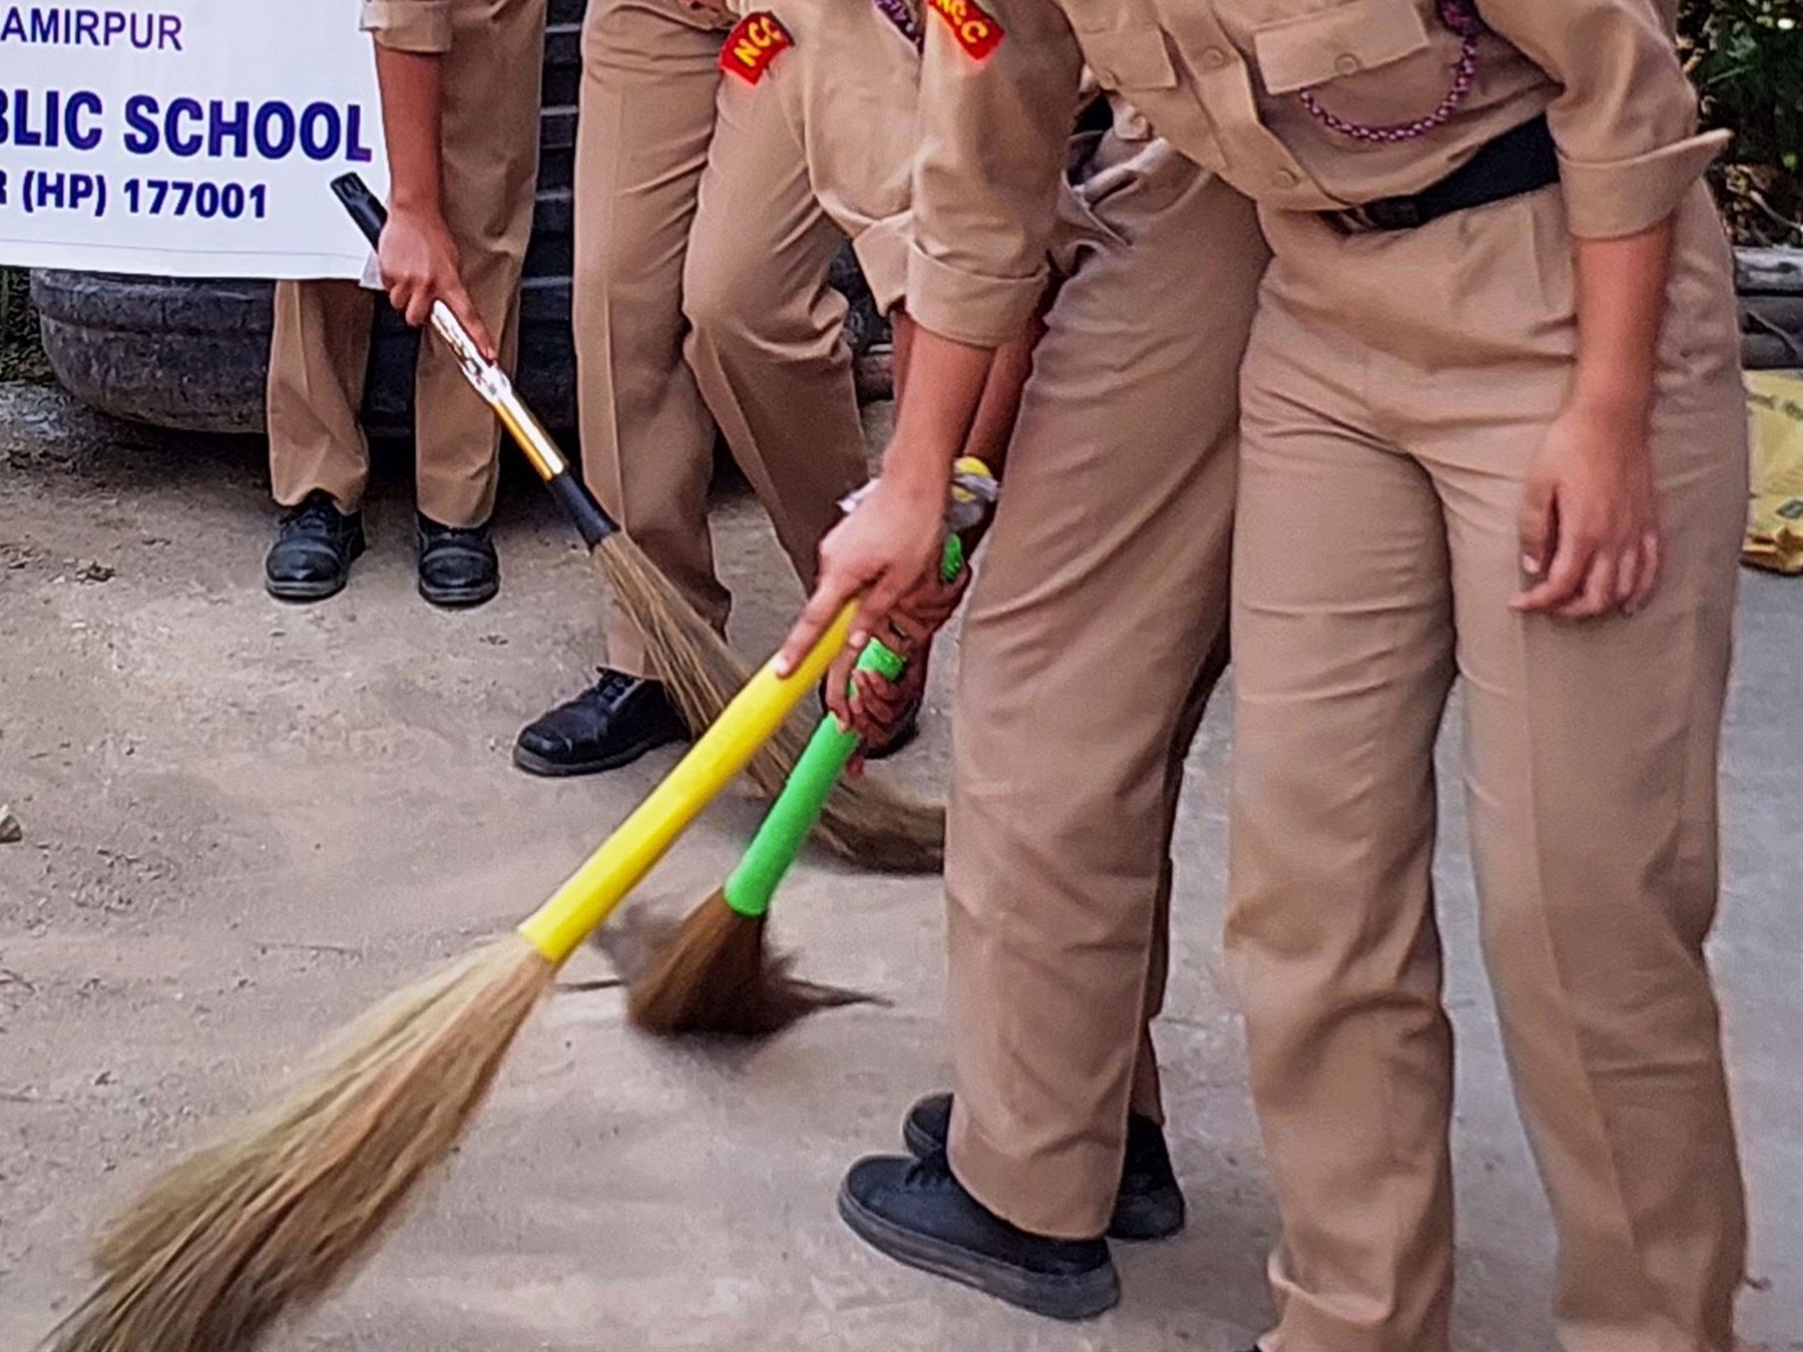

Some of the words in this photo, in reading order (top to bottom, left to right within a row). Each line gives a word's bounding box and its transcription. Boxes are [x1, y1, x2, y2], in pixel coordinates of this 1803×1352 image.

[733, 16, 783, 68] NCC
[123, 94, 373, 164] SCHOOL
[22, 170, 108, 217] (HP)
[123, 177, 267, 220] 177001
